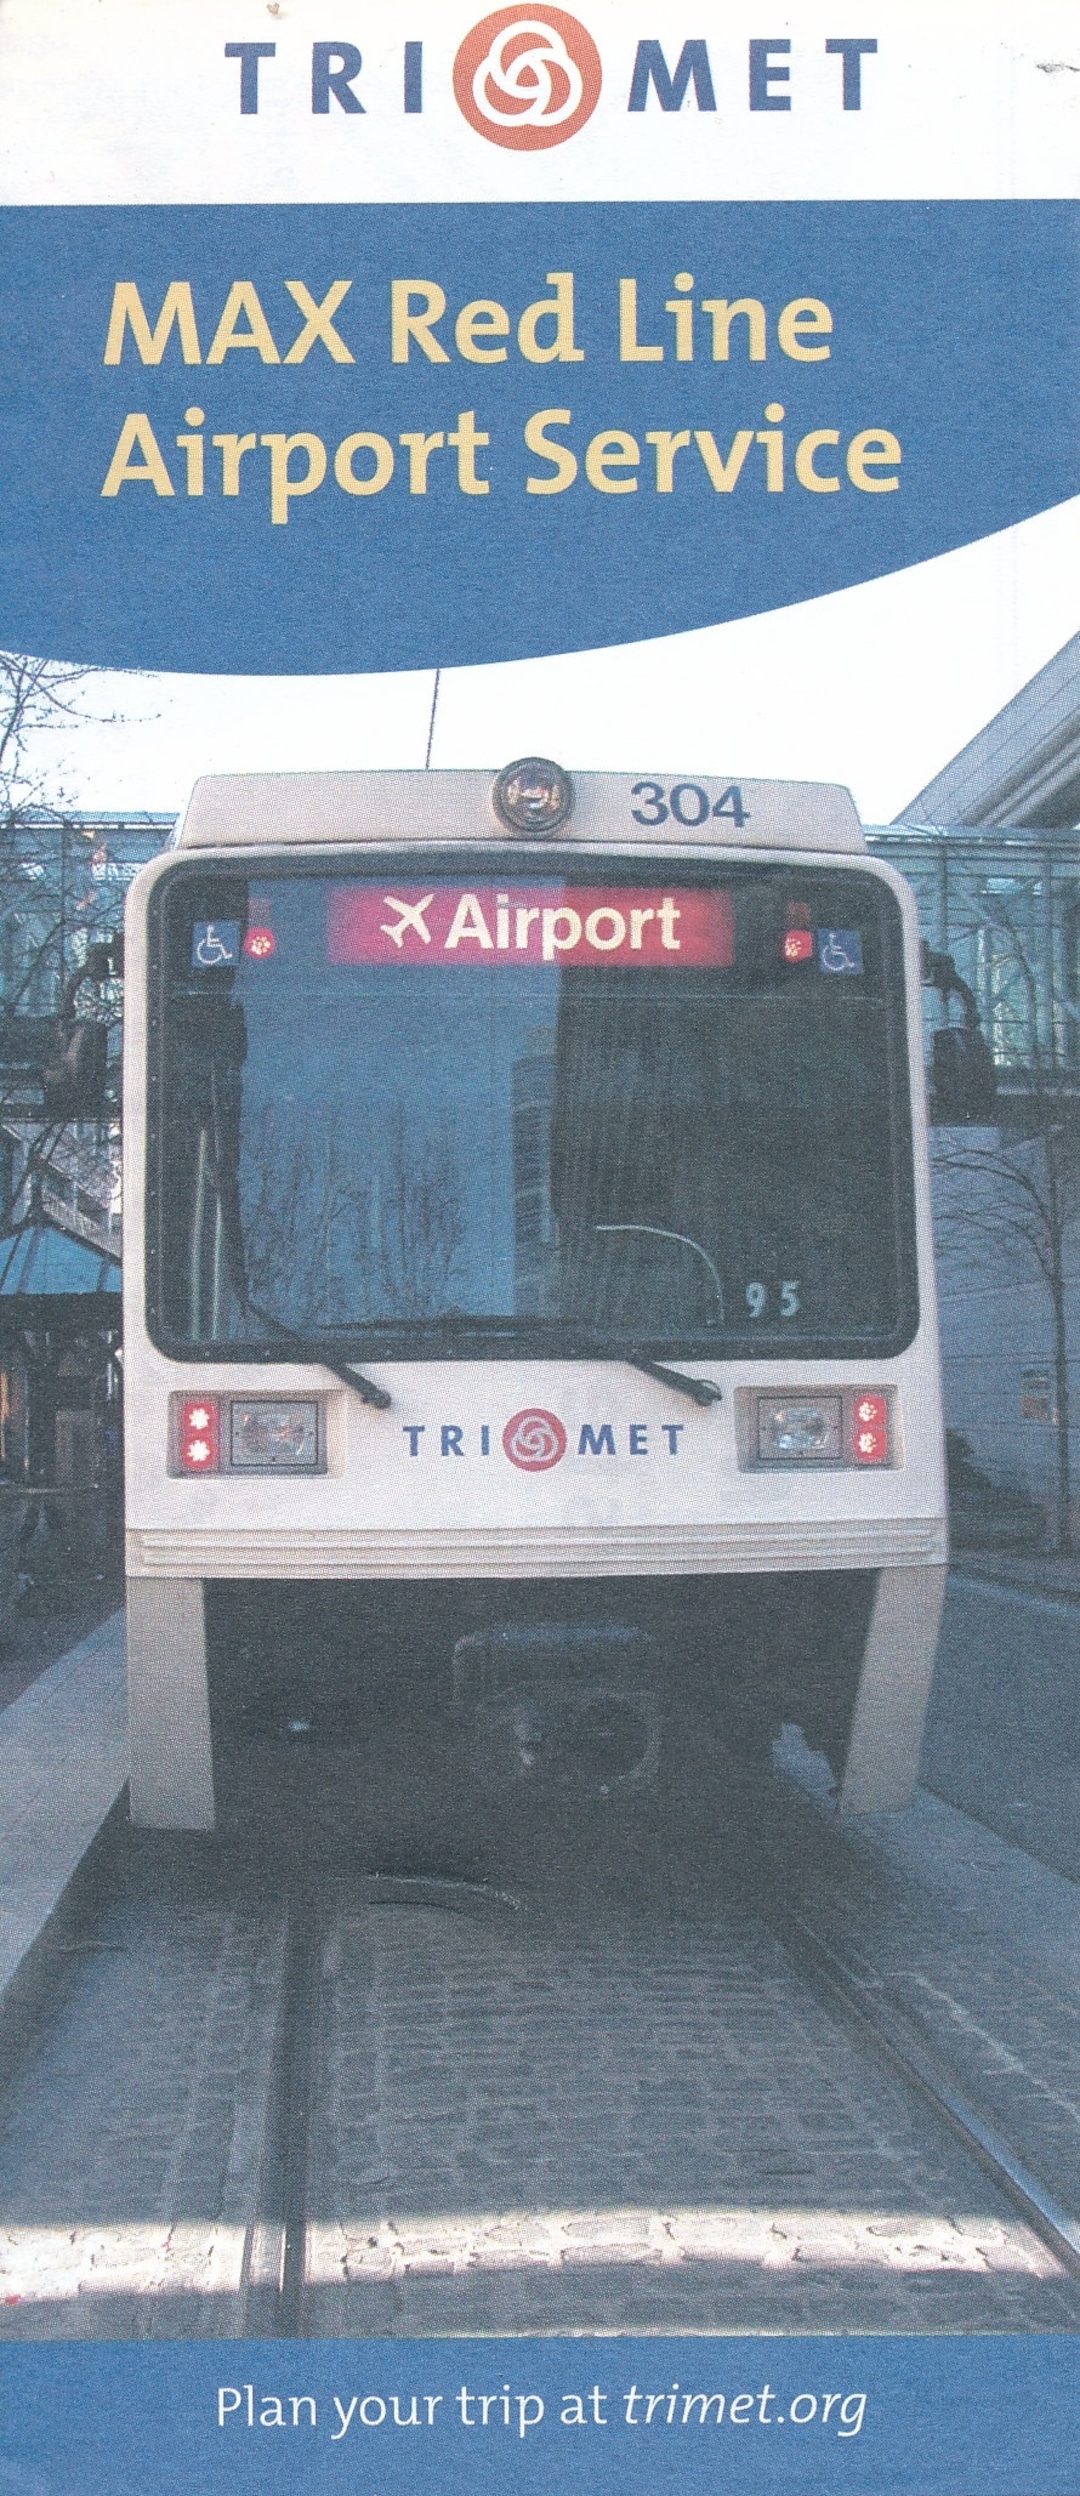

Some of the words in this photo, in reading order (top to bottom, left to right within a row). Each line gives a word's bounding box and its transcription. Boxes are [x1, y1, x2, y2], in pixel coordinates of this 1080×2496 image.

[103, 280, 353, 365] MAX
[391, 272, 584, 363] Red
[621, 272, 834, 362] Line
[101, 408, 489, 524] Airport
[526, 402, 902, 494] Service
[631, 781, 750, 828] 304
[444, 893, 681, 959] Airport
[217, 2385, 317, 2427] Plan
[331, 2395, 441, 2439] your
[455, 2384, 544, 2439] trip
[561, 2392, 607, 2427] at
[623, 2384, 868, 2438] trimet.org
